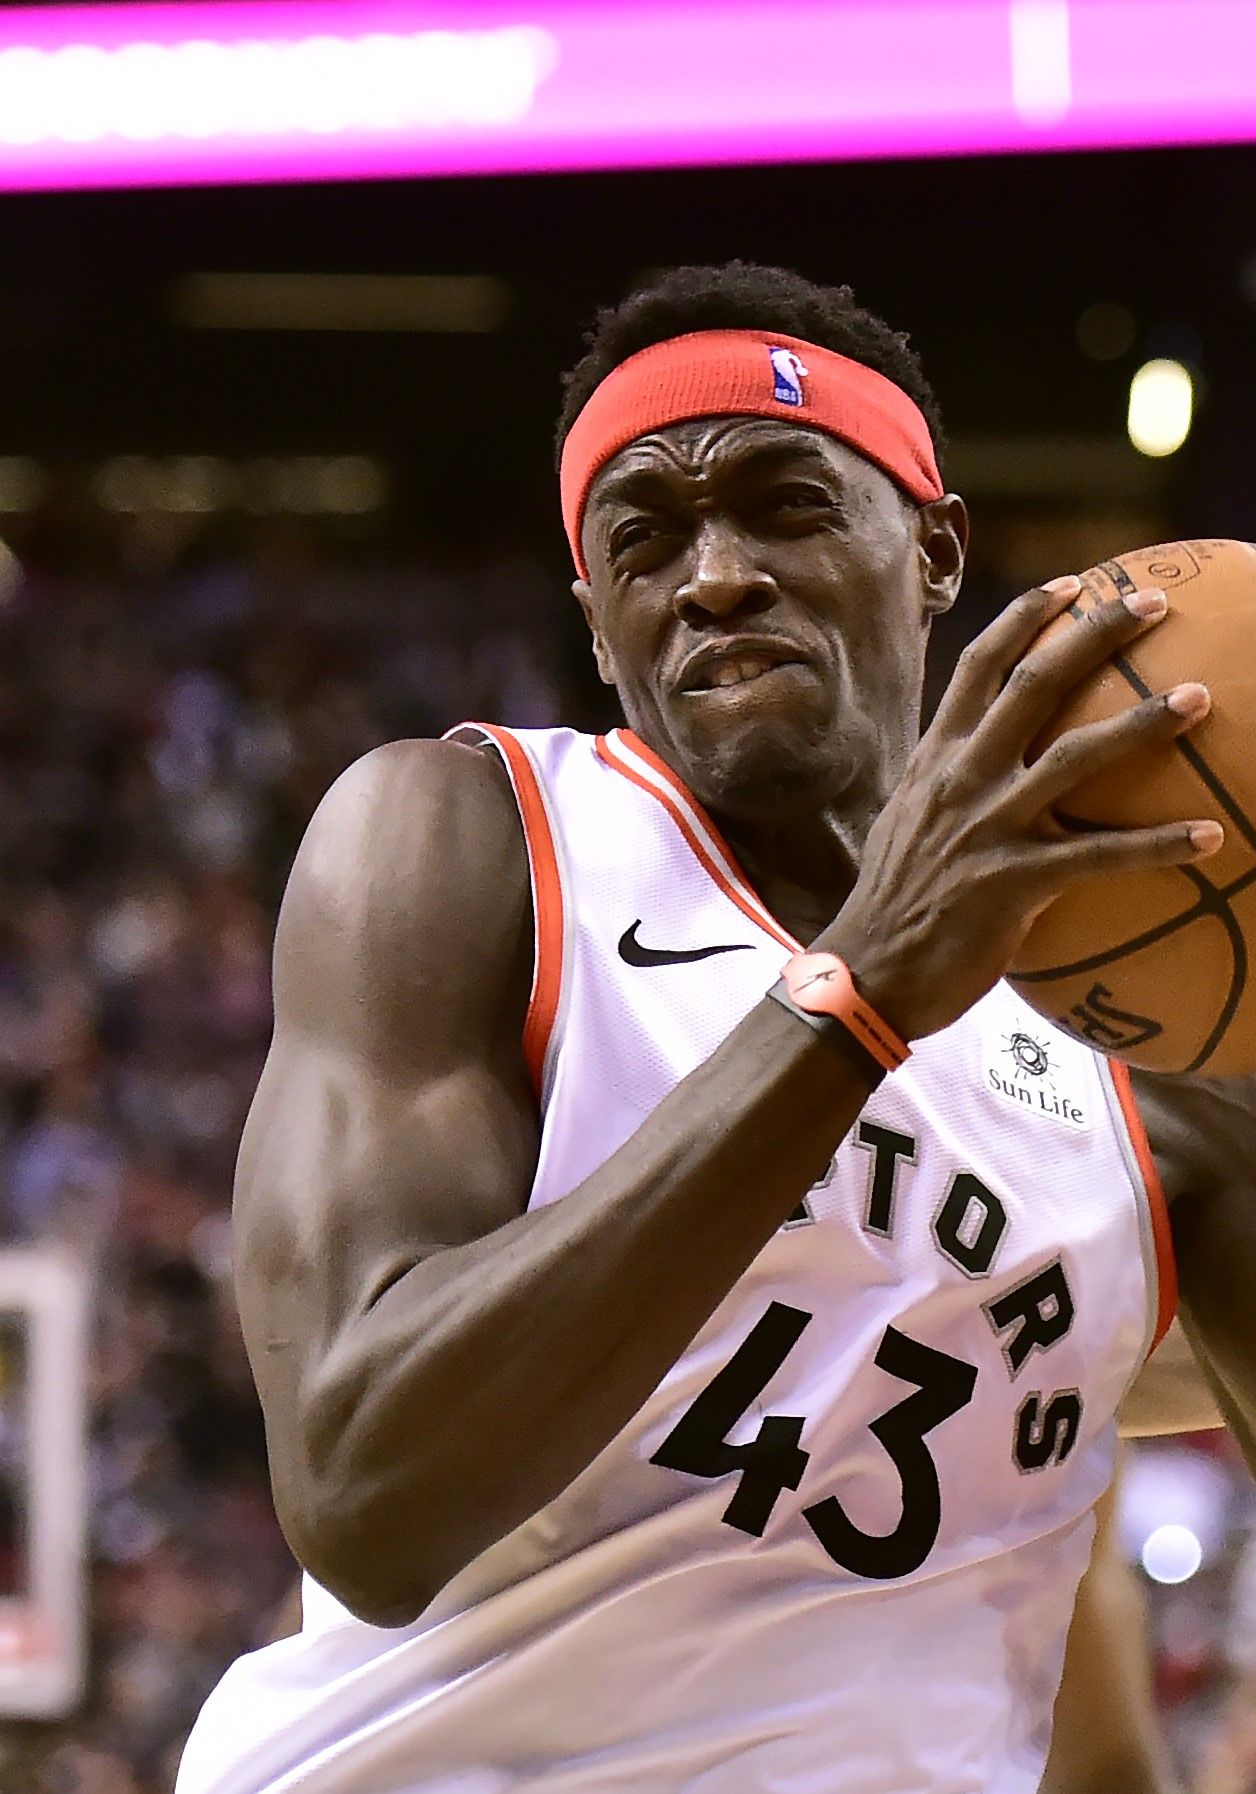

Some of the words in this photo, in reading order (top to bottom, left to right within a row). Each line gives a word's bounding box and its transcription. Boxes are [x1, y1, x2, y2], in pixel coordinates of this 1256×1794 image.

[988, 1067, 1033, 1105] Sun
[1038, 1089, 1085, 1124] Life
[782, 1118, 1084, 1476] TORS
[649, 1301, 979, 1580] 43
